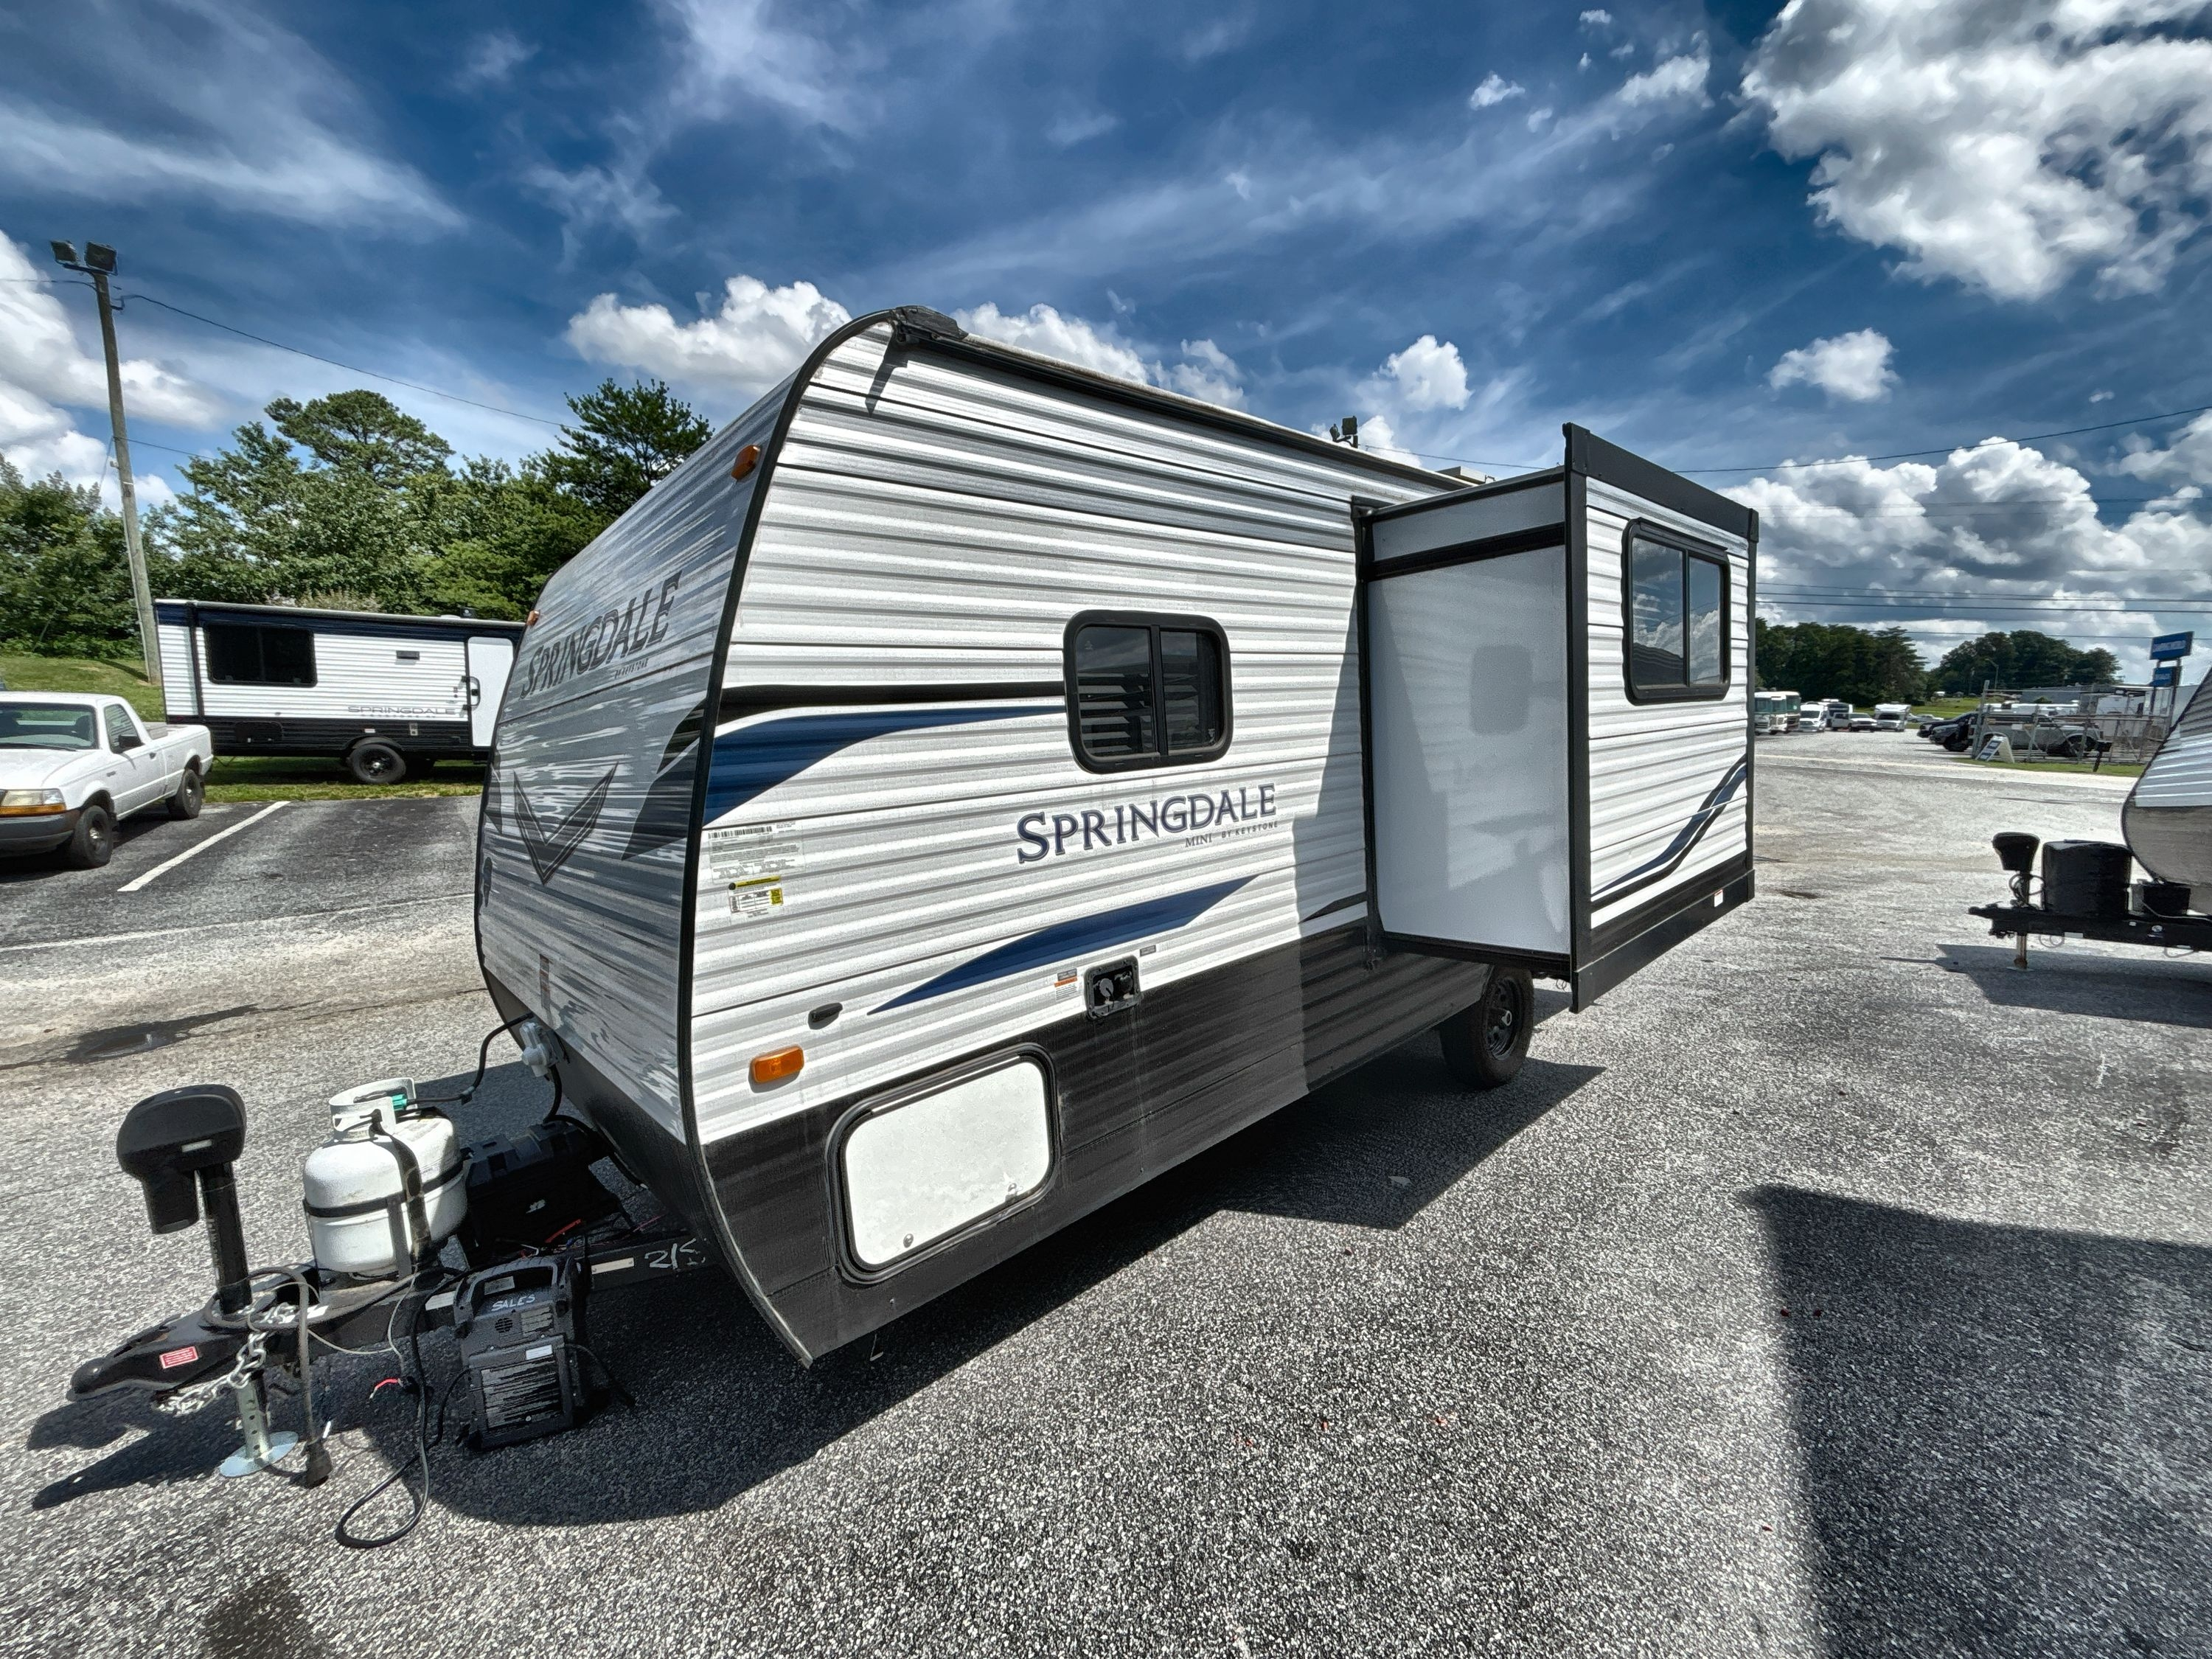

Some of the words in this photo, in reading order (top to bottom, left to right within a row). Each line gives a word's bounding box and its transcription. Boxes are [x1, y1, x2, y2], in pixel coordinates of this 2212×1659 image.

[519, 570, 683, 700] SPRINGDALE
[348, 706, 456, 714] SPRINGDALE
[1017, 783, 1277, 863] SPRINGDALE
[1185, 833, 1213, 847] MINI
[1221, 830, 1231, 838] BY
[1235, 821, 1278, 835] KEYSTONE
[491, 1294, 535, 1312] SALES
